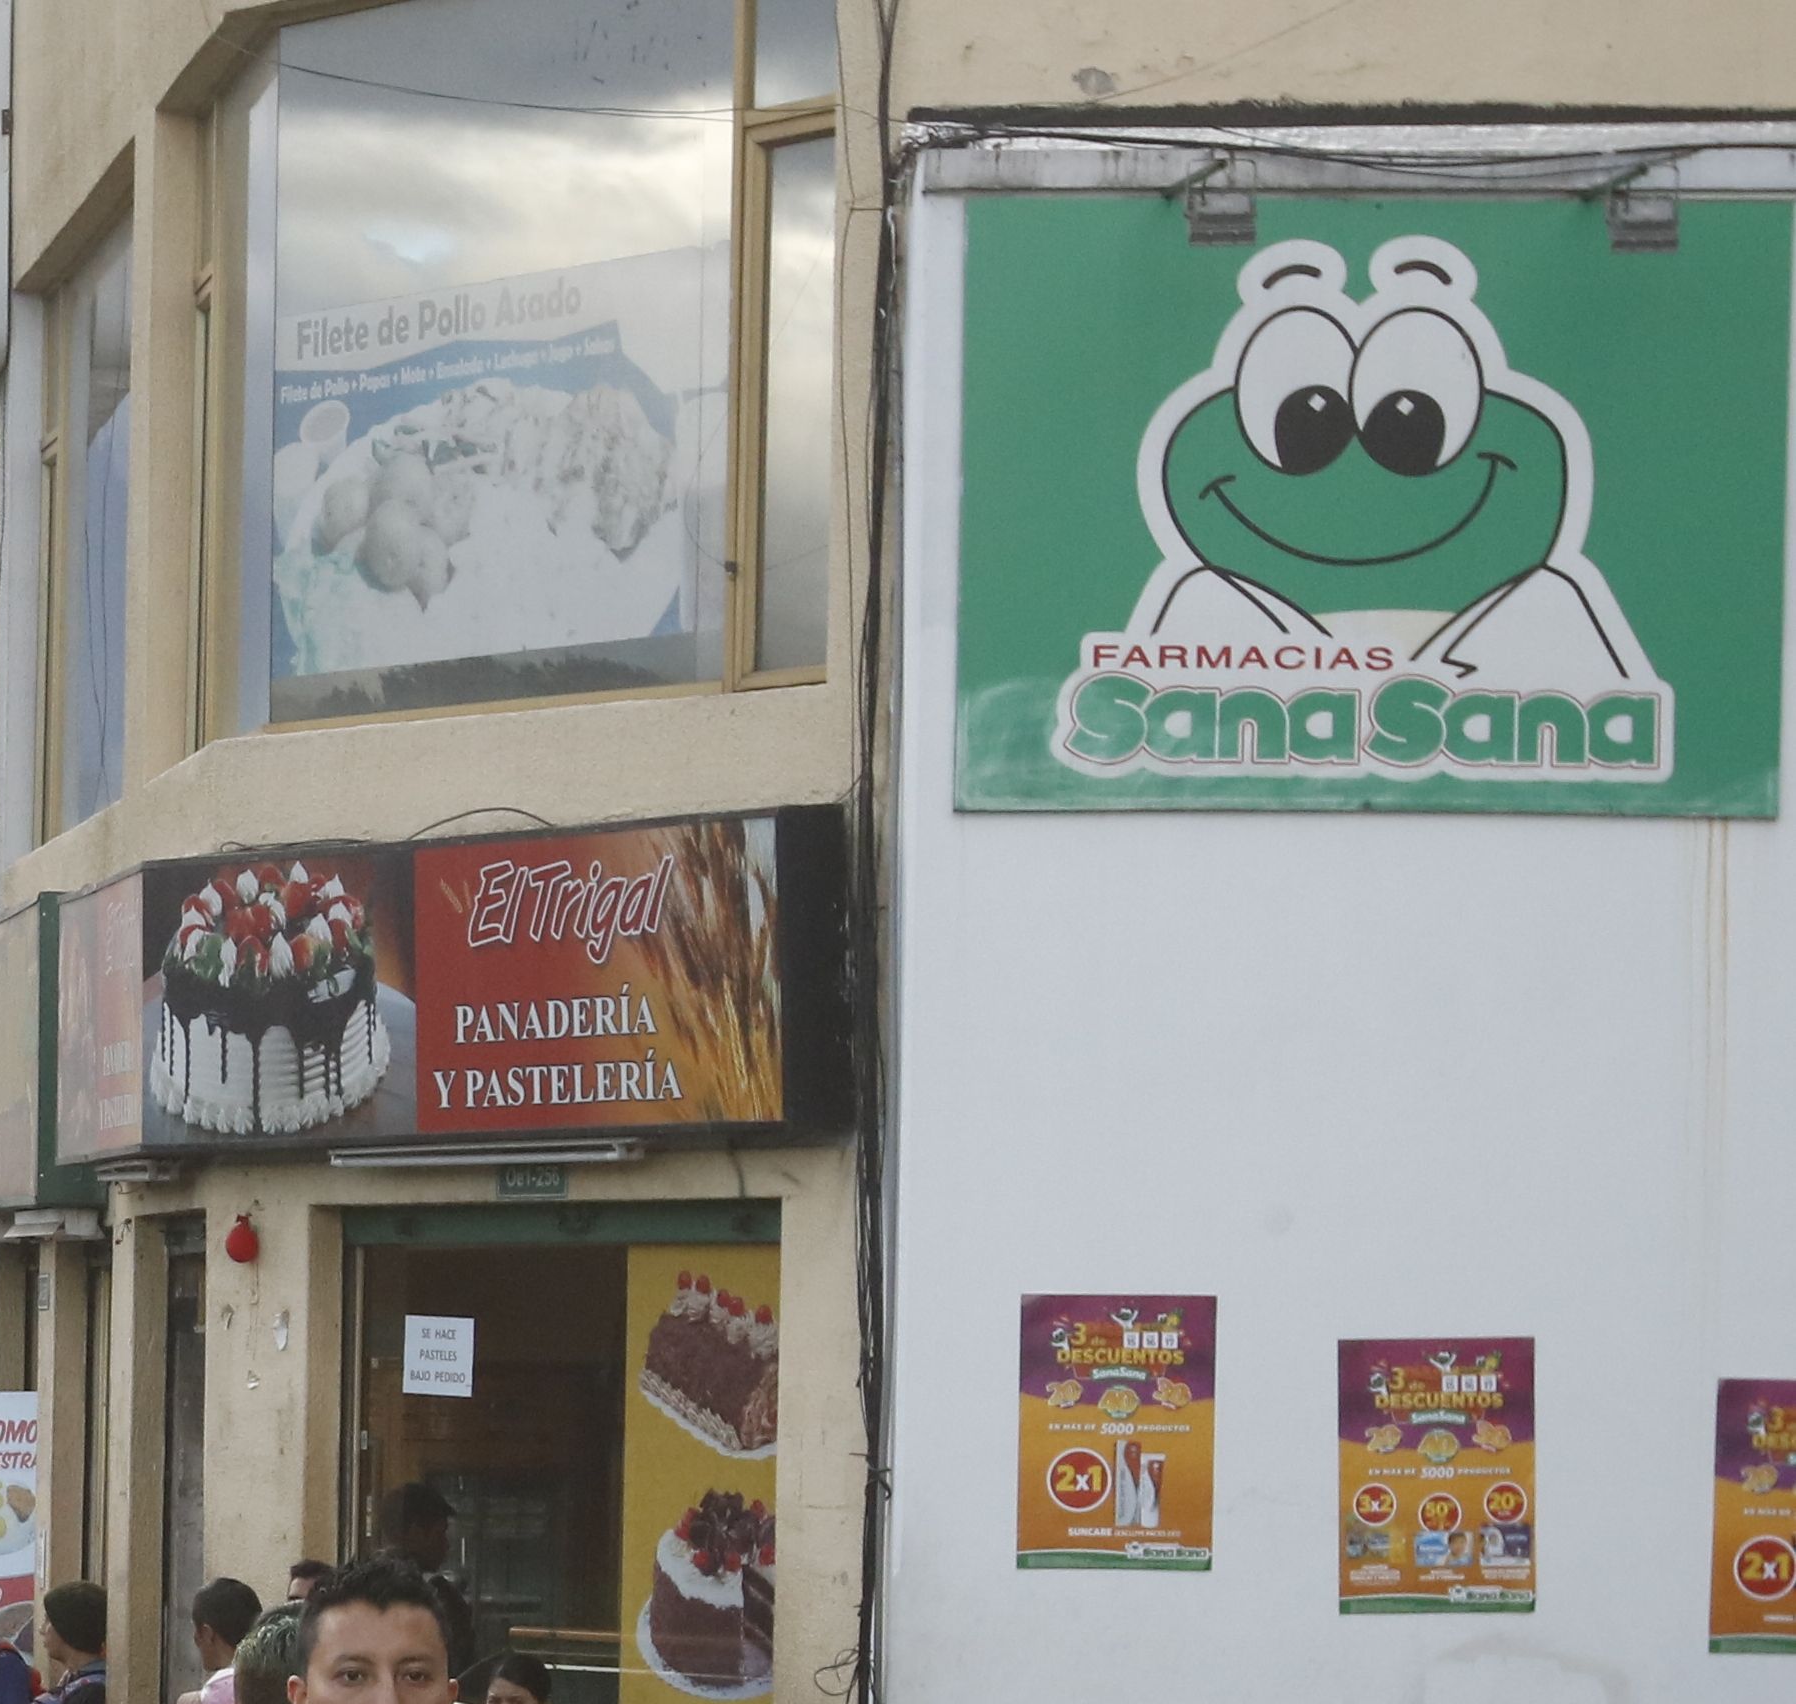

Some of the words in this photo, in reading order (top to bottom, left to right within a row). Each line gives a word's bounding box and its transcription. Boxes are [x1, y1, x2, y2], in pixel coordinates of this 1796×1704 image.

[297, 316, 369, 361] Filete
[378, 306, 410, 347] de
[418, 293, 487, 341] Pollo
[495, 276, 582, 327] Asado
[1092, 645, 1394, 671] FARMACIAS
[527, 854, 674, 964] Trigal
[455, 983, 657, 1045] PANADERÍA
[433, 1069, 458, 1110] Y
[465, 1049, 683, 1108] PASTELERÍA
[421, 1328, 431, 1339] SE
[435, 1329, 457, 1340] HACE
[1071, 1323, 1088, 1345] 3
[419, 1349, 457, 1362] PASTELES
[1057, 1348, 1185, 1365] DESCUENTOS
[410, 1369, 431, 1381] BAJO
[434, 1371, 466, 1383] PEDIDO
[1389, 1367, 1405, 1391] 3
[1375, 1392, 1504, 1409] DESCUENTOS
[1100, 1423, 1135, 1434] 5000
[1056, 1463, 1103, 1492] 2x1
[1421, 1467, 1455, 1478] 5000
[1742, 1552, 1790, 1581] 2x1
